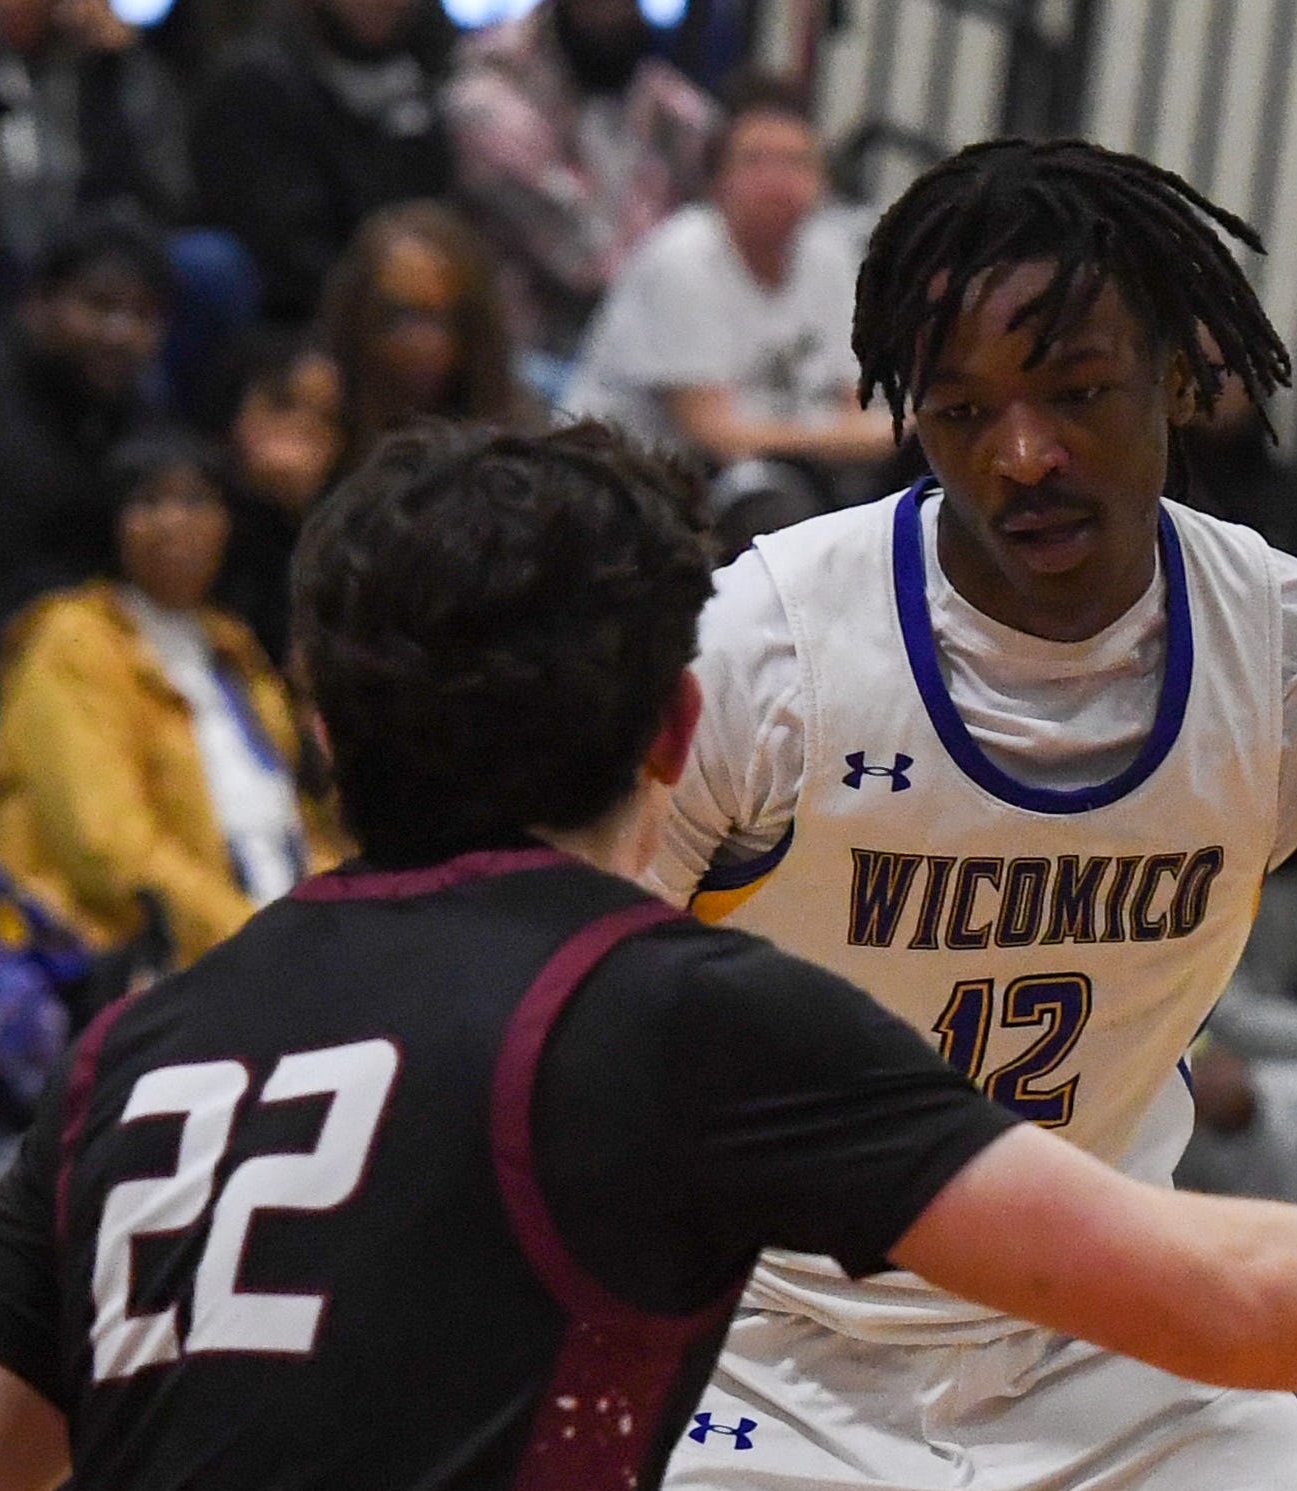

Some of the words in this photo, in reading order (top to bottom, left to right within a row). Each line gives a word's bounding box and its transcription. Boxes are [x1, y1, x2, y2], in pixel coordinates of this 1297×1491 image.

[847, 845, 1225, 951] WICOMICO
[931, 971, 1093, 1129] 12
[88, 1036, 402, 1385] 22
